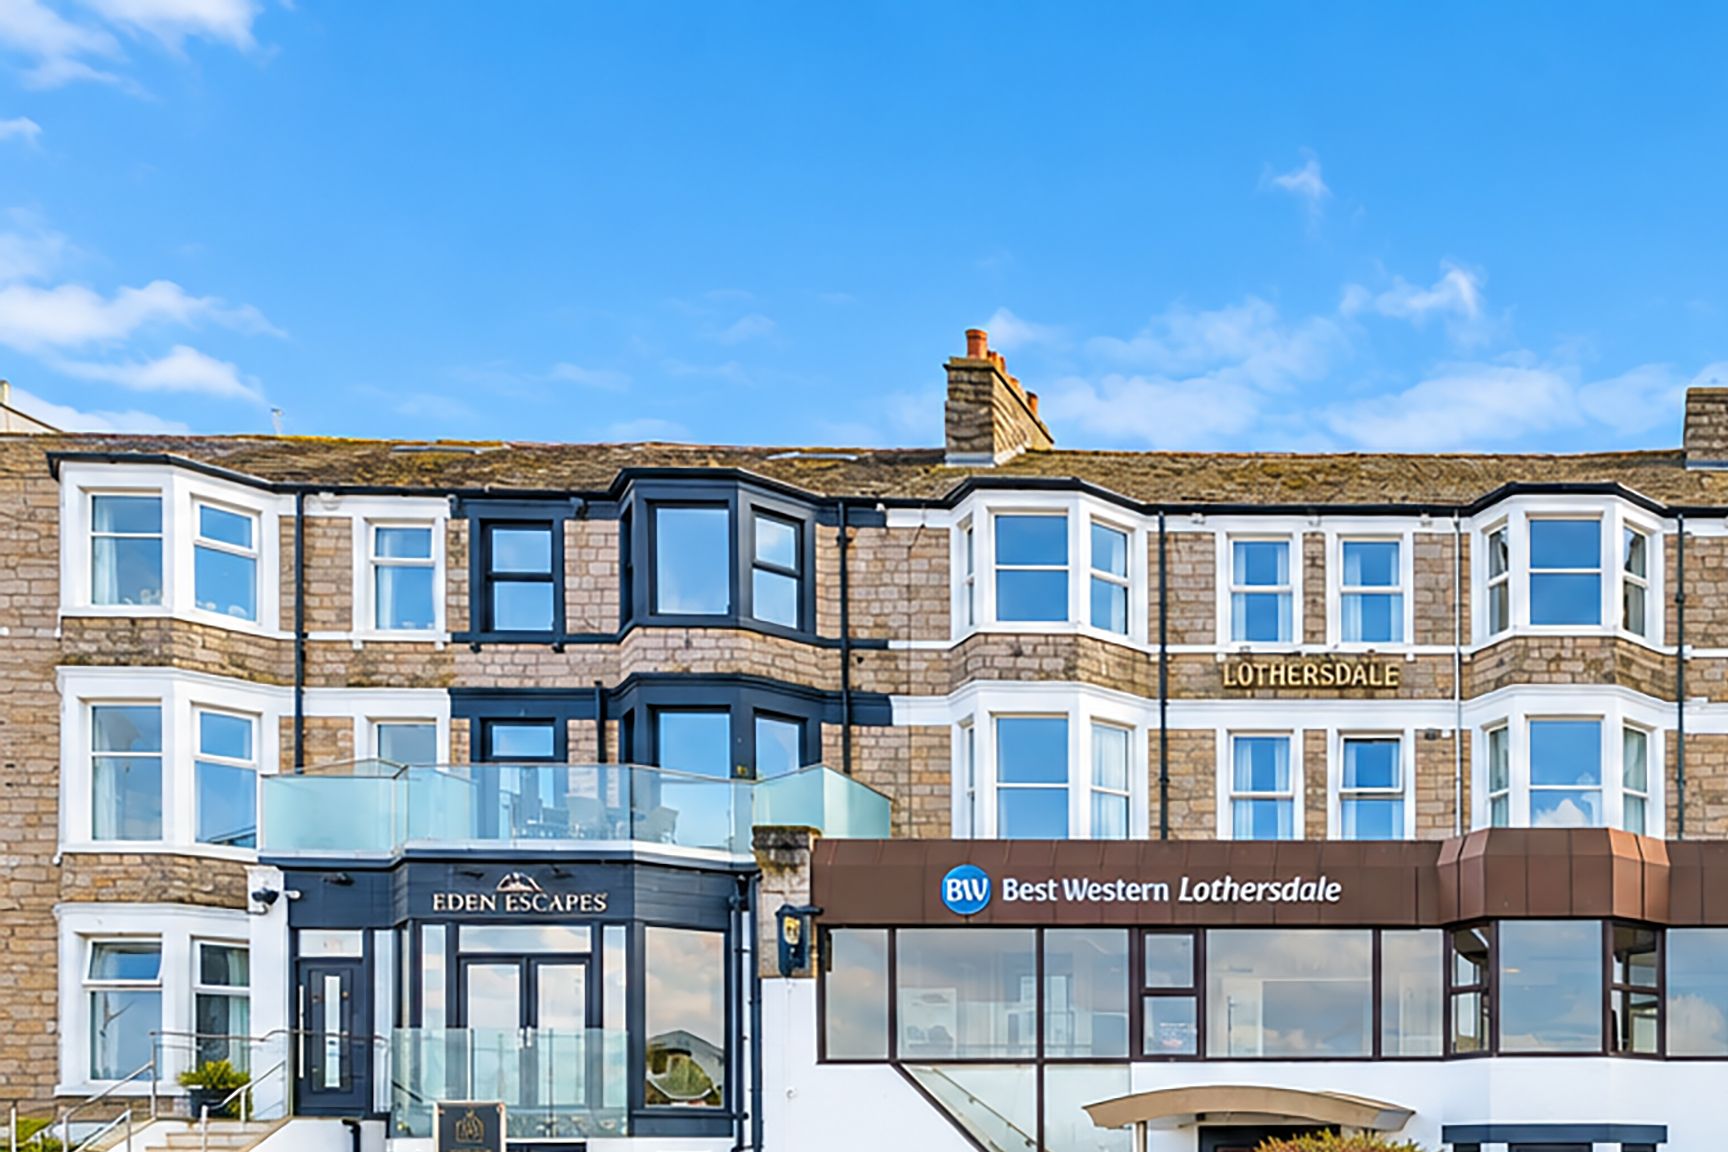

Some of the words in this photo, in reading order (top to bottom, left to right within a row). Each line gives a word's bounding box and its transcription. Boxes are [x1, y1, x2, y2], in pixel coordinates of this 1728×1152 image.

[1223, 662, 1400, 687] LOTHERSDALE
[1002, 878, 1059, 902] Best
[1063, 878, 1169, 902] Western
[1178, 875, 1342, 903] Lothersdale
[432, 893, 497, 912] EDEN
[505, 892, 608, 912] ESCAPES
